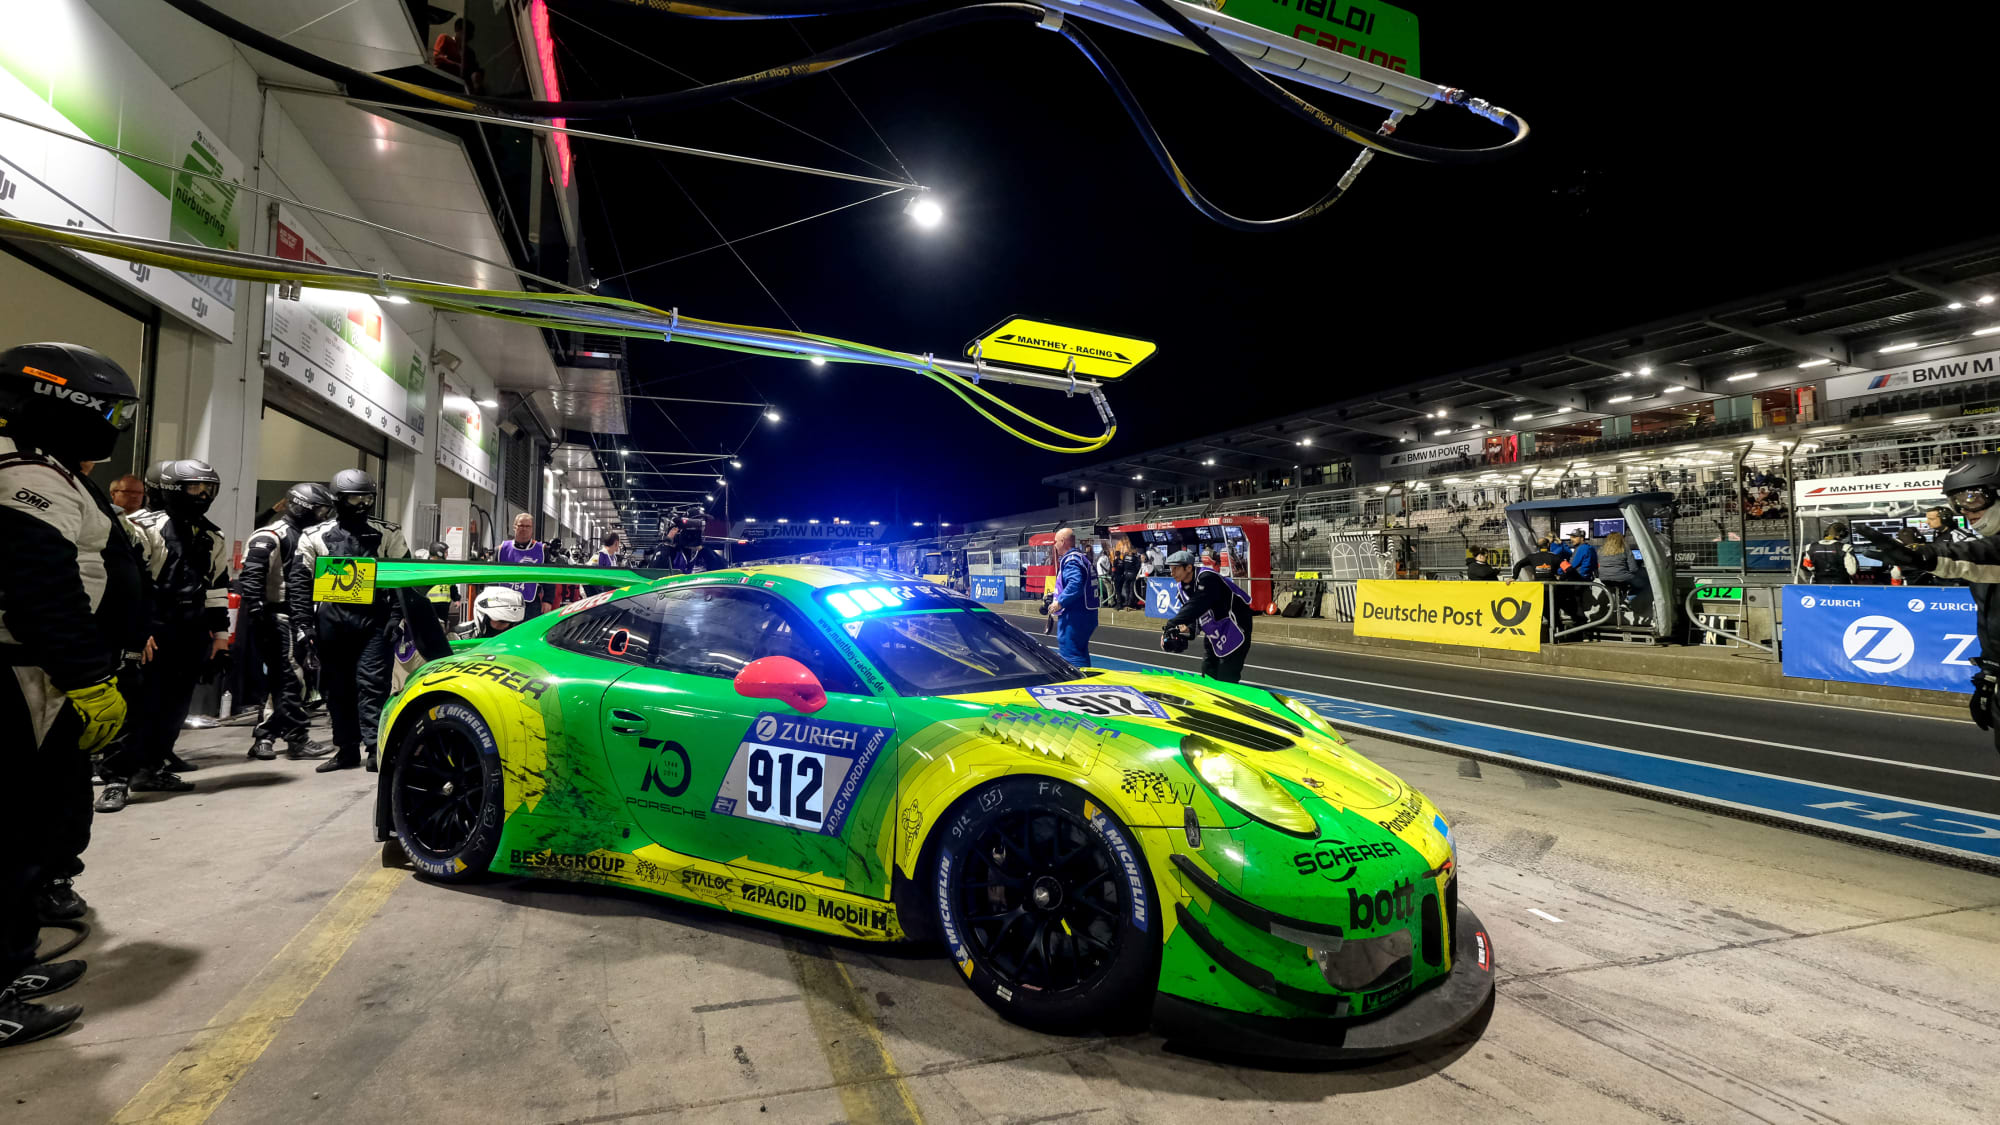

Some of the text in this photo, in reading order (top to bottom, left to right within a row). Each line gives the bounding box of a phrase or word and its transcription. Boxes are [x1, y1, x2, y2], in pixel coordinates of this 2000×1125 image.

[175, 185, 226, 237] nürburgring
[1018, 336, 1068, 350] MANTHEY
[1076, 346, 1113, 358] RACING
[1912, 362, 1968, 383] BMW
[1974, 358, 1994, 374] M
[33, 381, 107, 412] uvex
[1407, 444, 1470, 462] BMW M POWER
[1830, 482, 1890, 492] MANTHEY
[1903, 479, 1944, 488] RACIN
[15, 489, 51, 510] OMP
[826, 526, 874, 538] POWER
[1362, 602, 1482, 627] Deutsche Post
[1820, 598, 1860, 608] ZURICH
[1930, 602, 1978, 612] ZURICH
[818, 618, 885, 693] www.manthey-racing.de
[418, 661, 550, 700] SCHERER
[1056, 694, 1154, 716] 912
[446, 706, 493, 749] MICHELIN
[778, 722, 859, 750] ZURICH
[638, 737, 692, 798] 70
[748, 748, 824, 824] 912
[826, 728, 885, 836] ADAC NORDRHEIN
[626, 796, 706, 820] PORSCHE
[1378, 809, 1411, 836] Porsche
[400, 836, 444, 874] MICHELIN
[510, 850, 626, 873] BESAGROUP
[1294, 842, 1400, 876] SCHERER
[682, 870, 734, 892] STALOC
[1106, 828, 1146, 923] MICHELIN
[758, 888, 806, 913] PAGID
[818, 898, 868, 926] Mobil
[938, 856, 959, 945] MICHELIN
[1347, 877, 1414, 930] bott
